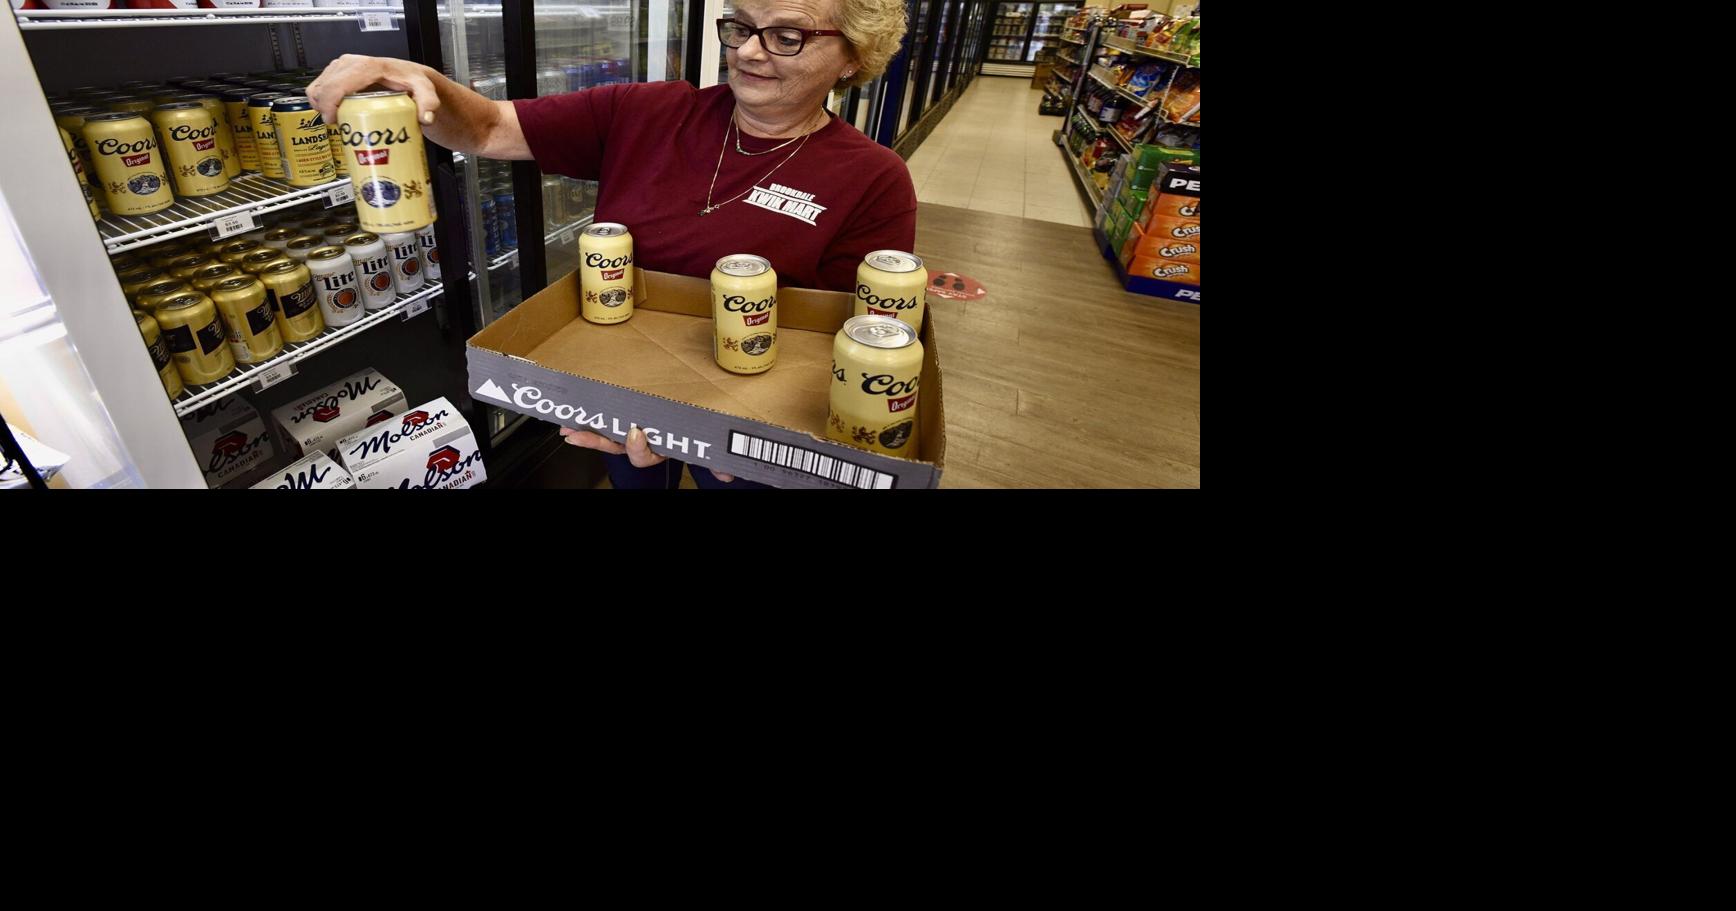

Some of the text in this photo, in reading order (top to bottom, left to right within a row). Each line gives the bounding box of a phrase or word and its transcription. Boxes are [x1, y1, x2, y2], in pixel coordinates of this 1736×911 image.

[340, 122, 411, 146] Coors
[769, 183, 816, 202] BROOKDALE
[747, 189, 823, 221] KWIK MART
[1160, 244, 1196, 257] Crush
[1154, 264, 1188, 277] Crush
[323, 271, 355, 291] Lite
[857, 281, 918, 310] Coors
[746, 313, 770, 326] Original
[512, 383, 608, 430] Coors
[349, 409, 449, 460] Molson
[409, 421, 444, 441] CANADIAN
